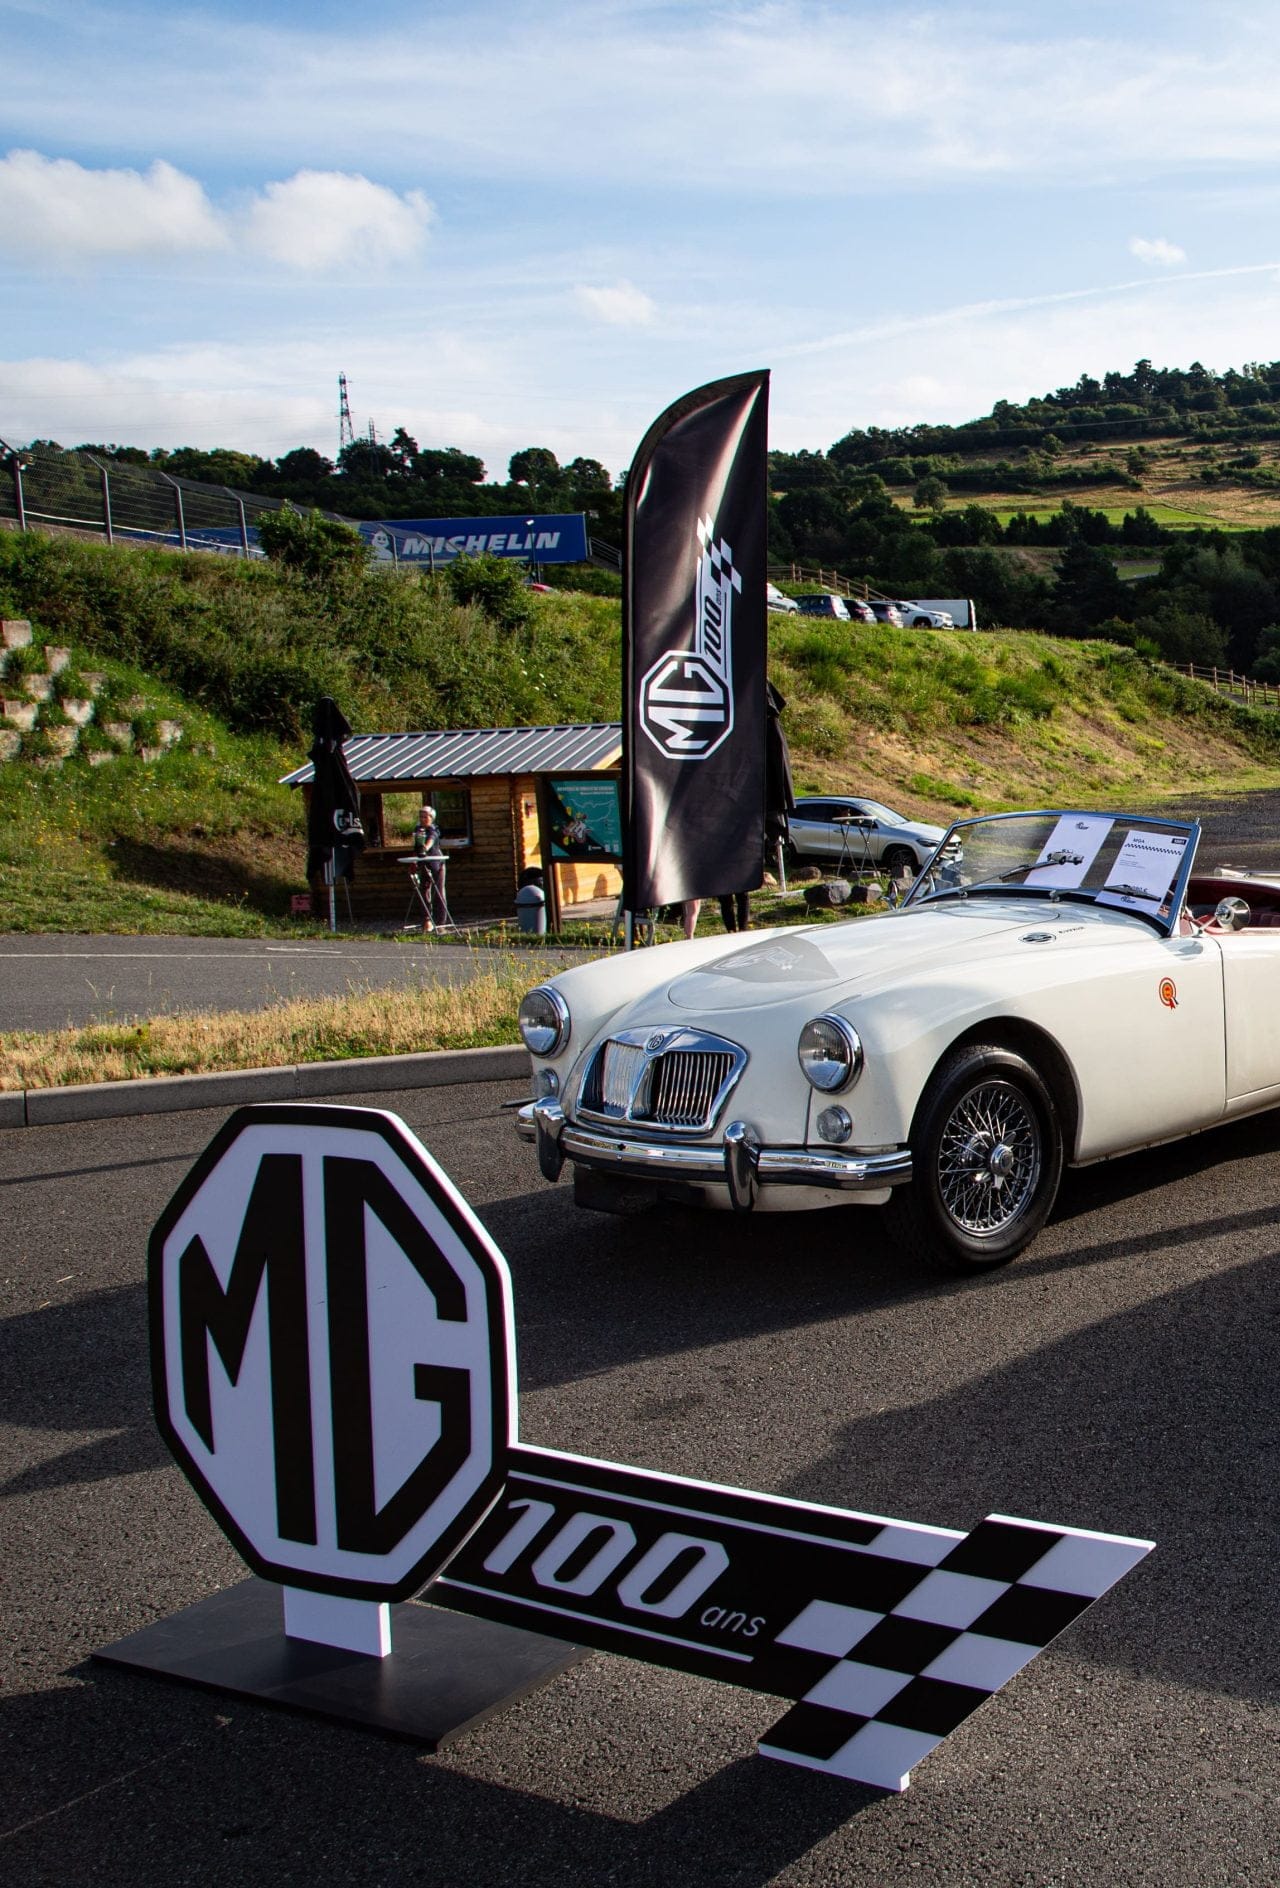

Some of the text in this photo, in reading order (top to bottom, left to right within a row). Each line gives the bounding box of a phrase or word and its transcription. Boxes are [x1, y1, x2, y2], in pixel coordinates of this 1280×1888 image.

[402, 532, 561, 555] MICHELIN
[704, 594, 722, 665] 100
[648, 661, 725, 750] MG
[178, 1153, 472, 1556] MG
[483, 1498, 766, 1638] 100 ans
